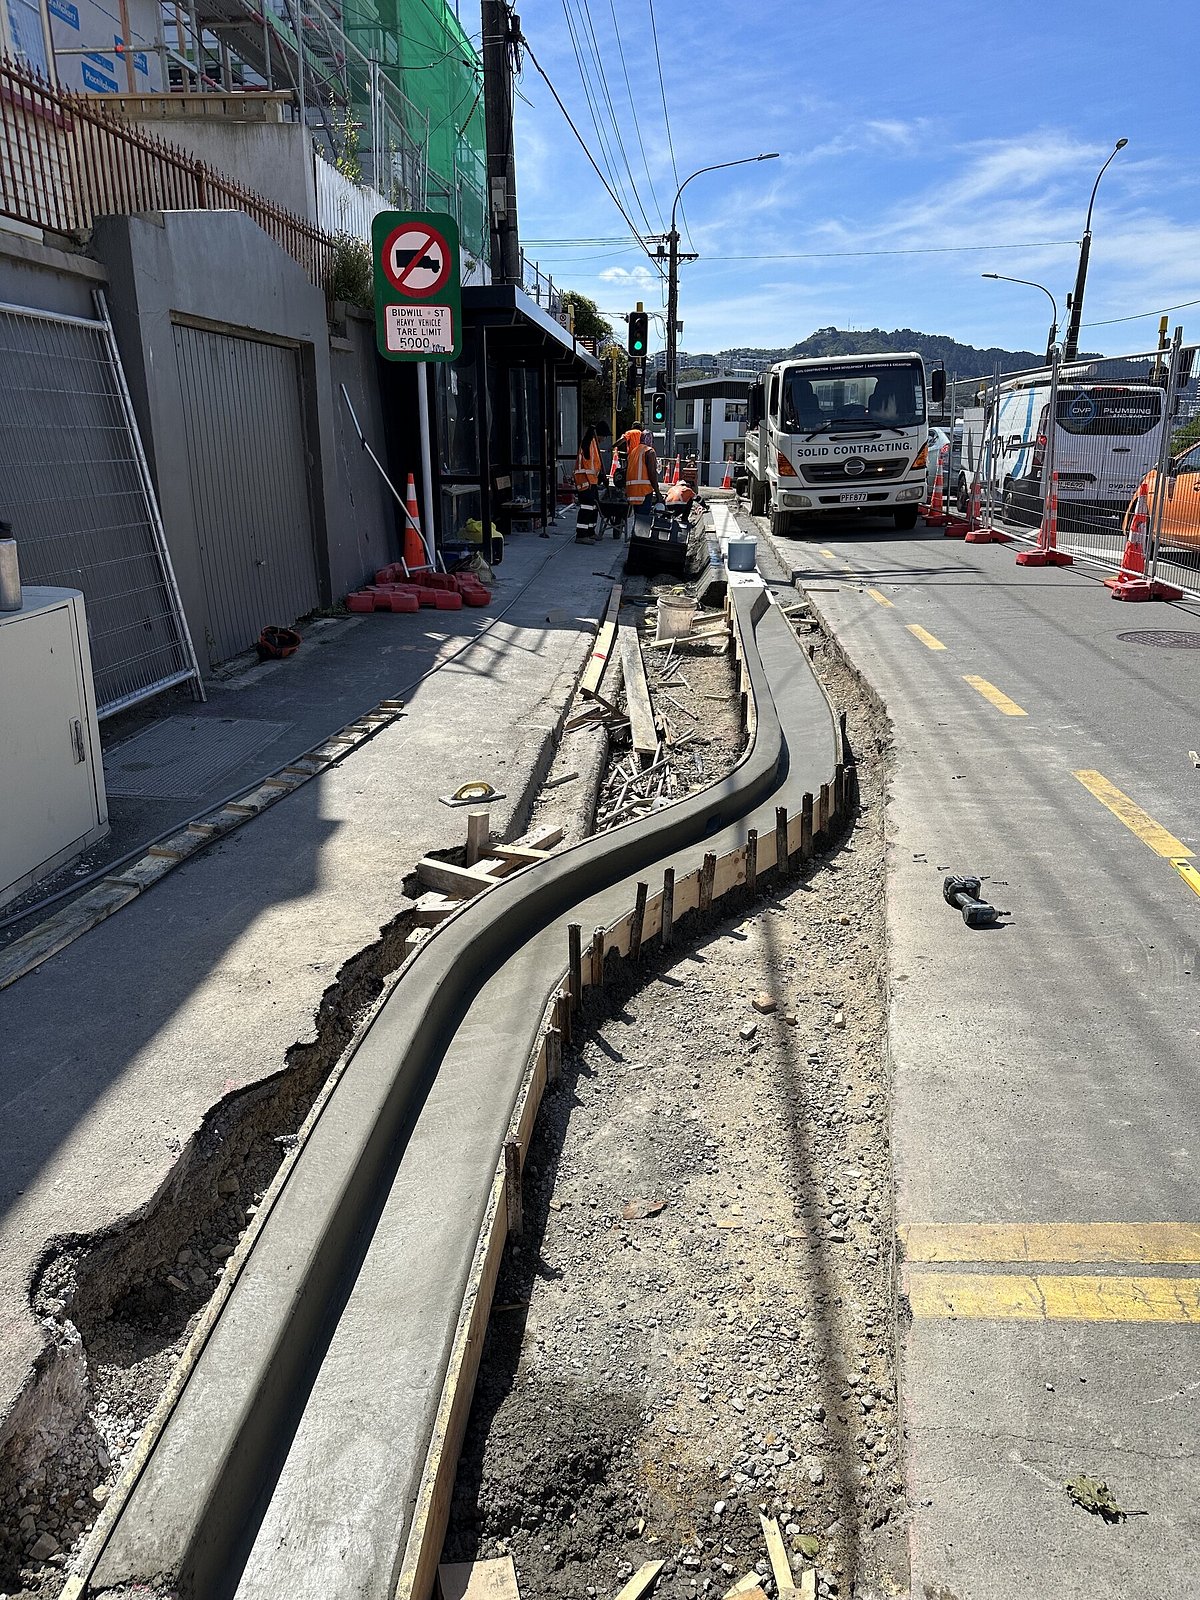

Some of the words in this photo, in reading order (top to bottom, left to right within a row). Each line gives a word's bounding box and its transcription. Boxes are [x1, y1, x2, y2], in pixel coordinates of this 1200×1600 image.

[391, 308, 423, 317] BIDWILL
[434, 309, 445, 317] ST
[396, 318, 415, 327] HEAVY
[418, 318, 441, 327] VEHICLE
[396, 327, 418, 336] TARE
[421, 328, 442, 336] LIMIT
[400, 337, 430, 349] 5000
[1103, 407, 1152, 415] PLUMBING
[797, 447, 829, 458] SOLID
[833, 442, 913, 456] CONTRACTING.
[841, 493, 868, 502] PFF877
